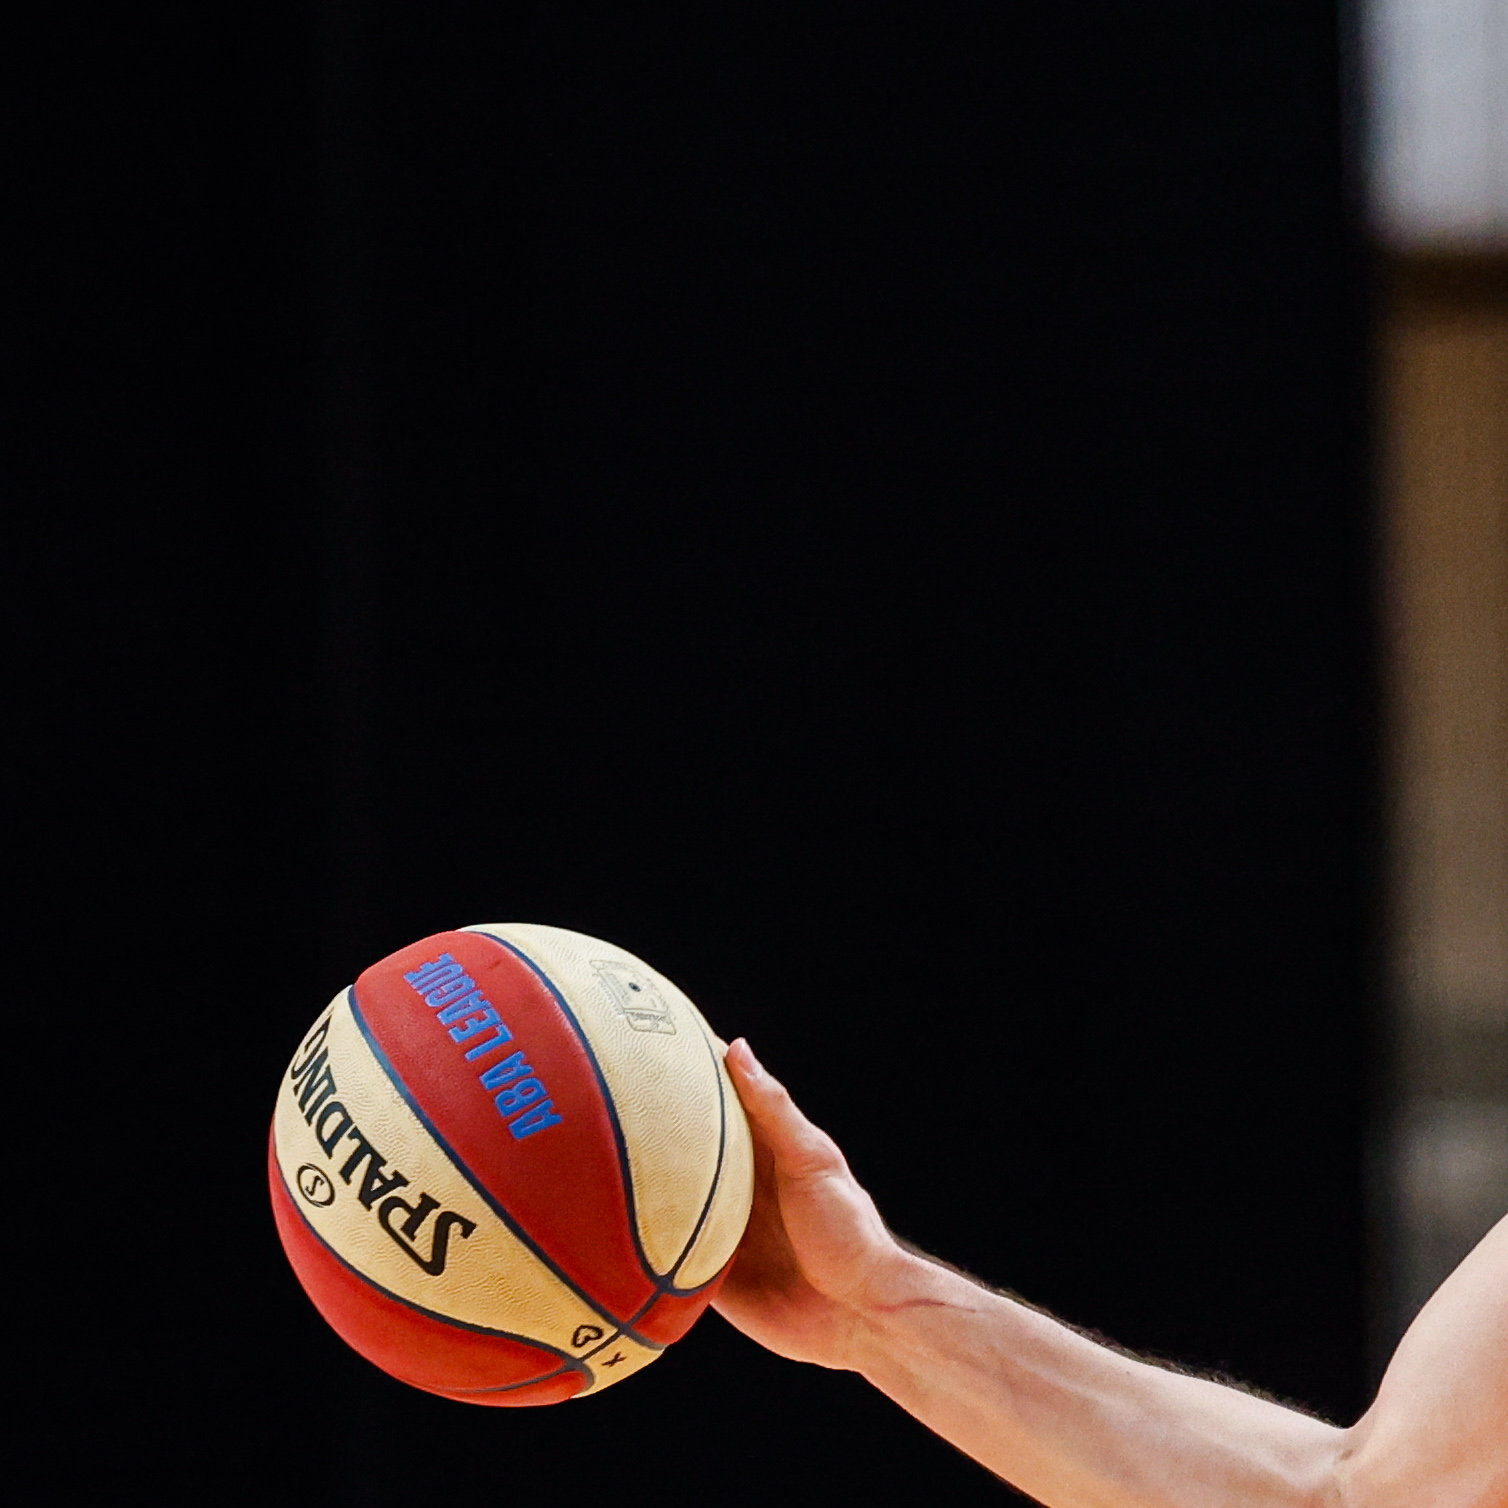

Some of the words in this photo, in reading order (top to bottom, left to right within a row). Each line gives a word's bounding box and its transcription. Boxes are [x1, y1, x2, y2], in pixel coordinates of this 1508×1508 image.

[403, 952, 514, 1062] LEAGUE
[290, 1012, 478, 1278] SPALDING
[479, 1050, 563, 1141] ABA
